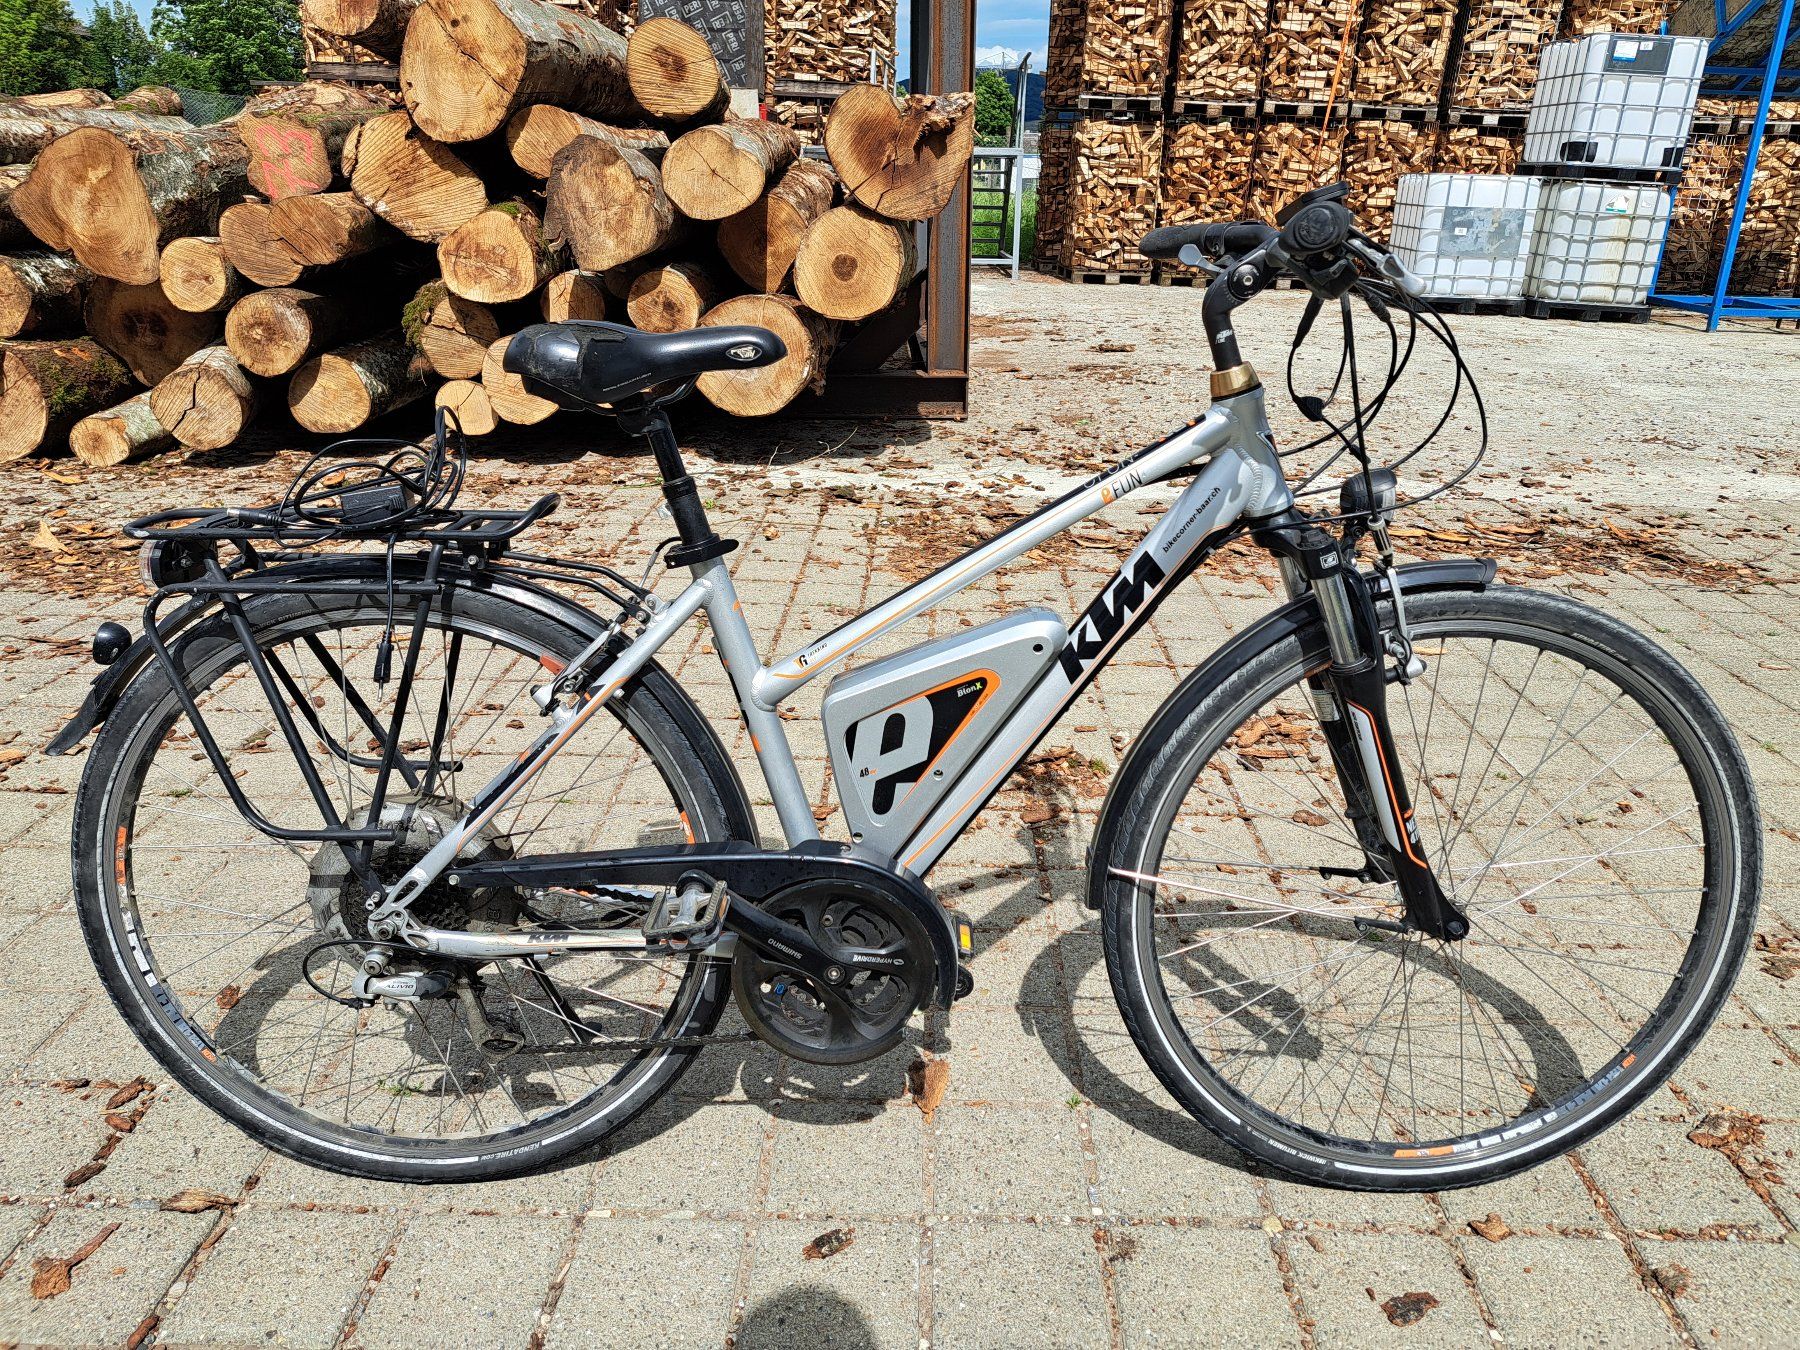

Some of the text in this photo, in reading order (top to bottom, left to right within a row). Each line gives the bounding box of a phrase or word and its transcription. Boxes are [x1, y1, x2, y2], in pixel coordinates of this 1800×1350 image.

[725, 31, 740, 51] PERI
[1111, 470, 1143, 499] FUN
[1162, 487, 1221, 553] bikecorner-baar.ch
[1060, 551, 1166, 685] KTM
[767, 938, 803, 960] SHIMANO
[853, 954, 892, 965] HYPERDRIVE
